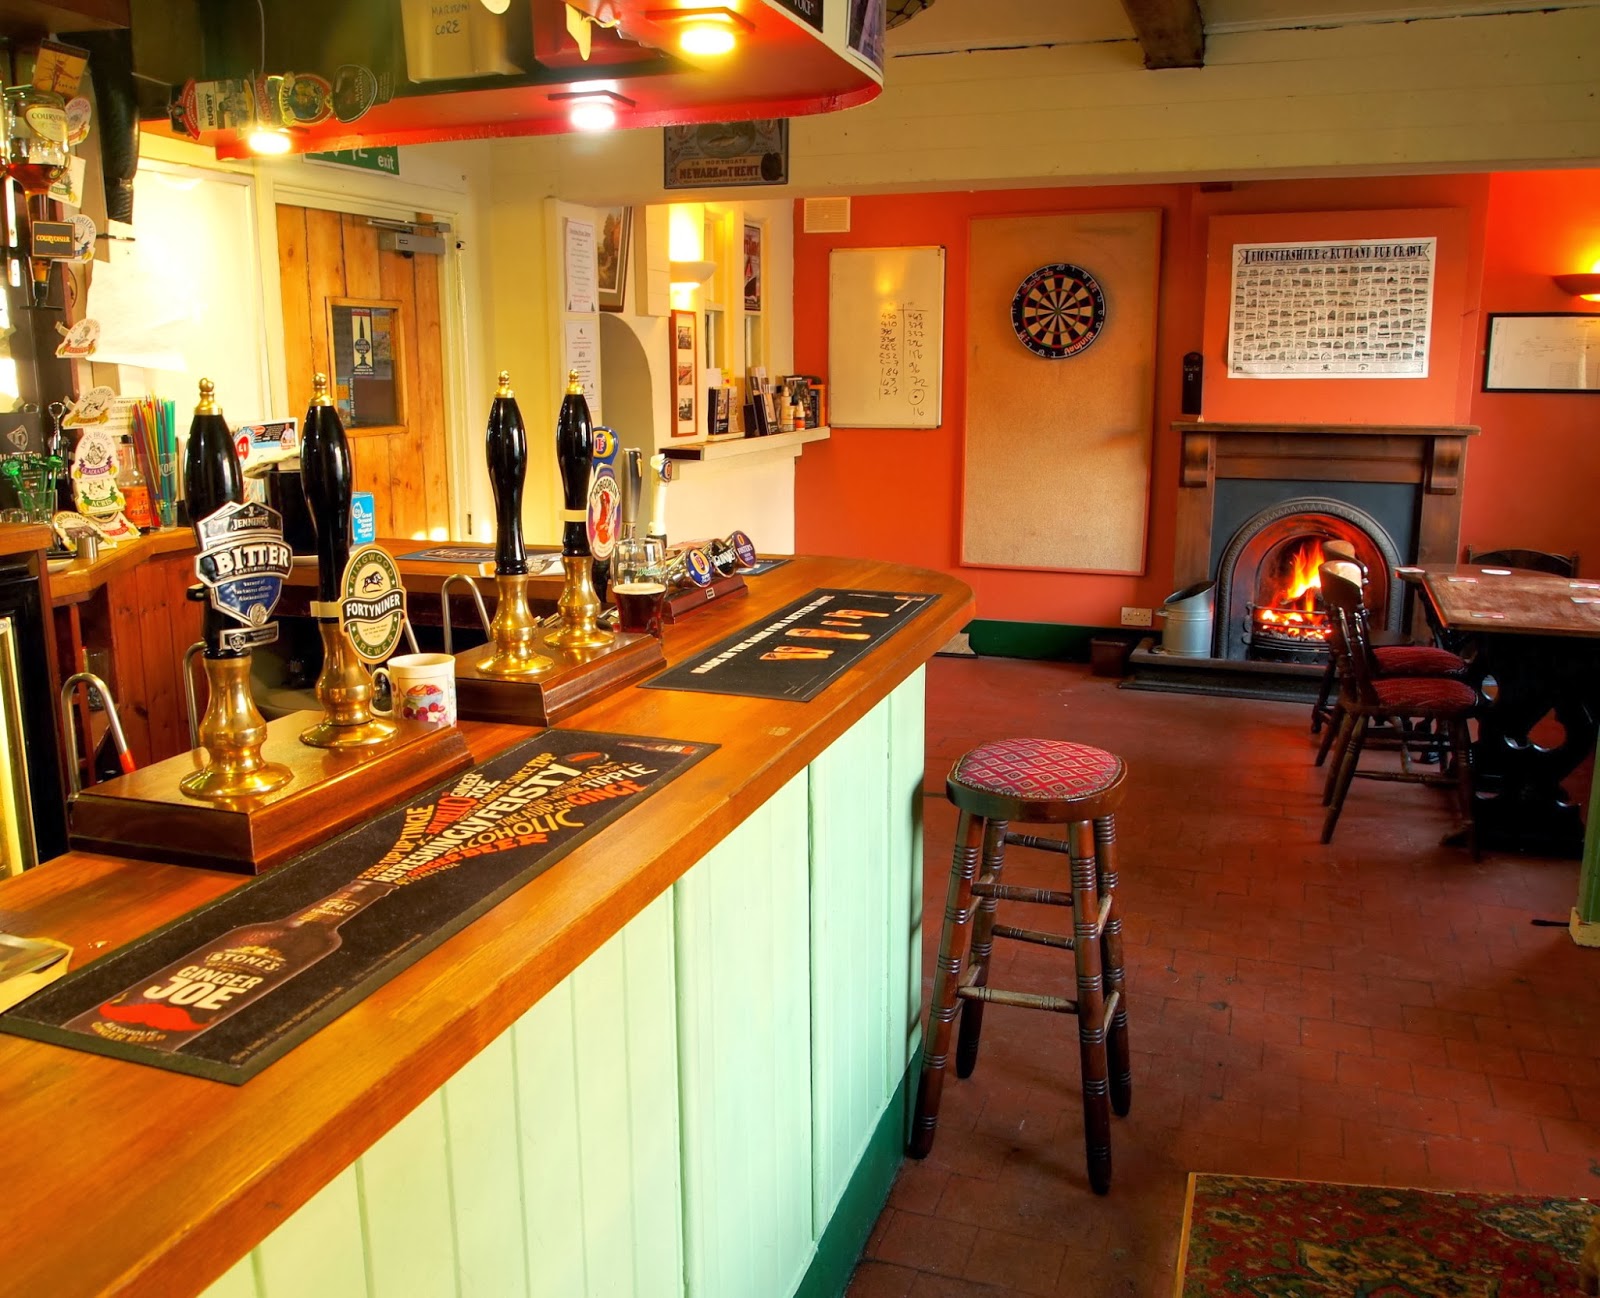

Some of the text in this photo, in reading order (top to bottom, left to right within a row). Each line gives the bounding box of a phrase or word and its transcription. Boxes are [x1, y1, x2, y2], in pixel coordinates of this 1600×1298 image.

[206, 93, 214, 126] RUGBY
[377, 154, 394, 170] exit
[679, 168, 718, 179] NEWARK
[728, 165, 759, 177] TRENT
[1245, 248, 1320, 265] LEICESTERSHIRE
[1331, 246, 1371, 260] RUTLAND
[1374, 246, 1391, 258] PUB
[1393, 244, 1424, 257] CRAWL
[232, 516, 269, 530] JENNINGS
[214, 545, 289, 575] BITTER
[350, 554, 394, 584] RINGWOOD
[346, 594, 401, 617] FORTYNINER
[354, 625, 396, 655] BREWERY
[450, 773, 481, 796] GINGER
[504, 766, 539, 783] SINCE
[582, 763, 658, 789] TIPPLE
[586, 766, 605, 780] ICE
[464, 779, 500, 797] JOE
[434, 796, 479, 822] HELLO
[498, 813, 523, 826] TAKE
[531, 801, 556, 816] DIP
[566, 780, 647, 806] GINGE
[372, 764, 582, 881] REFRESHINGLY FEISTY
[402, 804, 432, 840] TINGLE
[443, 809, 584, 857] ALCOHOLIC
[378, 852, 407, 863] TOP
[391, 841, 415, 851] UP
[407, 833, 548, 877] GINGER BEER
[209, 952, 281, 972] STONE'S
[176, 965, 264, 990] GINGER
[143, 975, 248, 1010] JOE
[104, 1021, 160, 1036] ALCOHOLIC
[127, 1033, 167, 1042] BEER
